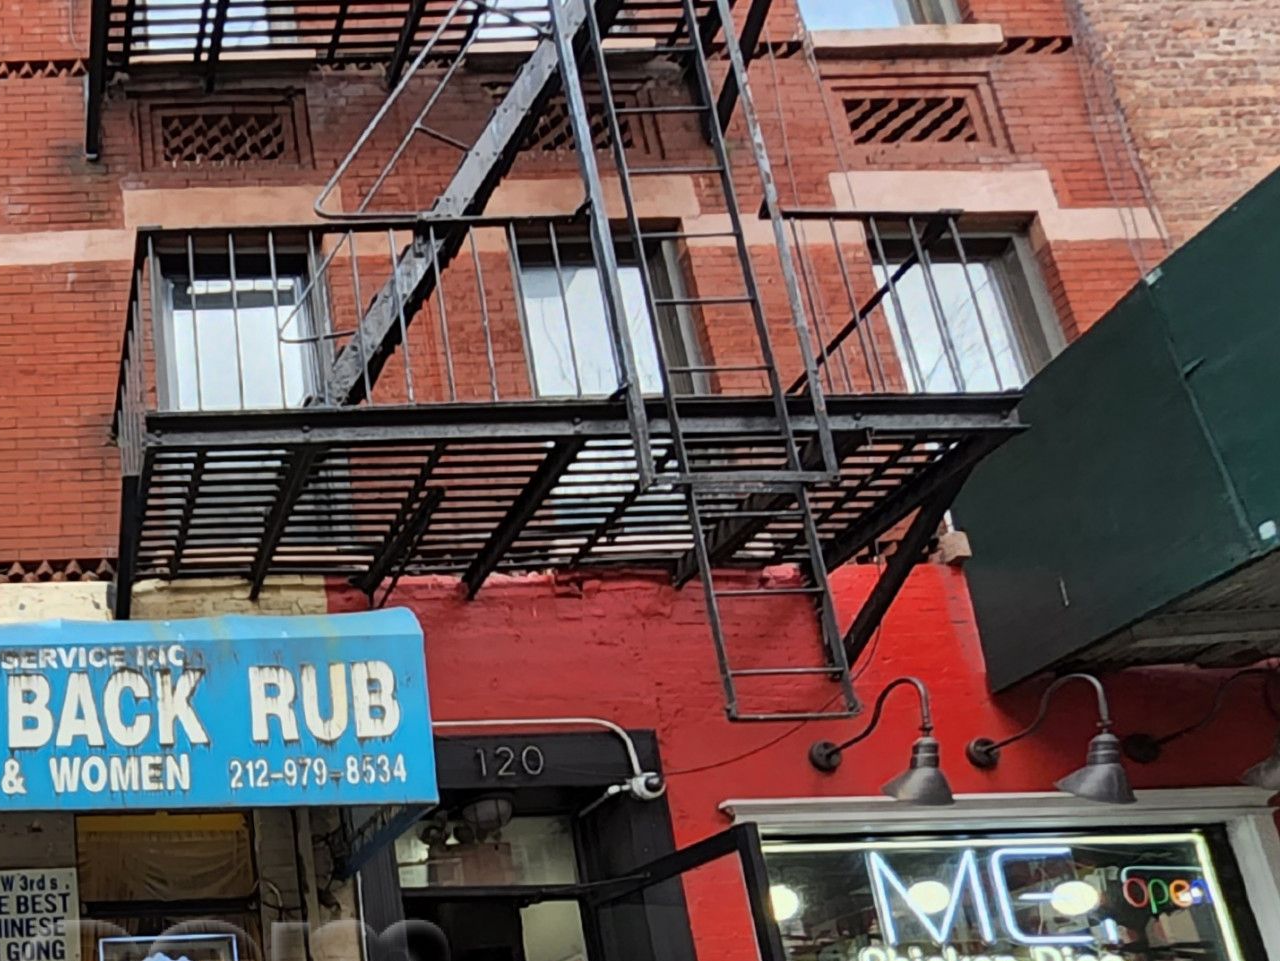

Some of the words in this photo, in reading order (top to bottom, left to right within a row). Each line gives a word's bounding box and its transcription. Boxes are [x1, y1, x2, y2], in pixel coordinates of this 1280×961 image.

[1, 646, 127, 670] SERVICE
[6, 668, 211, 749] BACK
[247, 660, 402, 742] RUB
[0, 757, 26, 795] &
[49, 753, 192, 793] WOMEN
[228, 753, 407, 789] 212-979-8534
[475, 745, 544, 777] 120
[1, 875, 14, 892] W
[19, 874, 46, 891] 3rd
[16, 893, 70, 915] BEST
[7, 940, 66, 961] GONG
